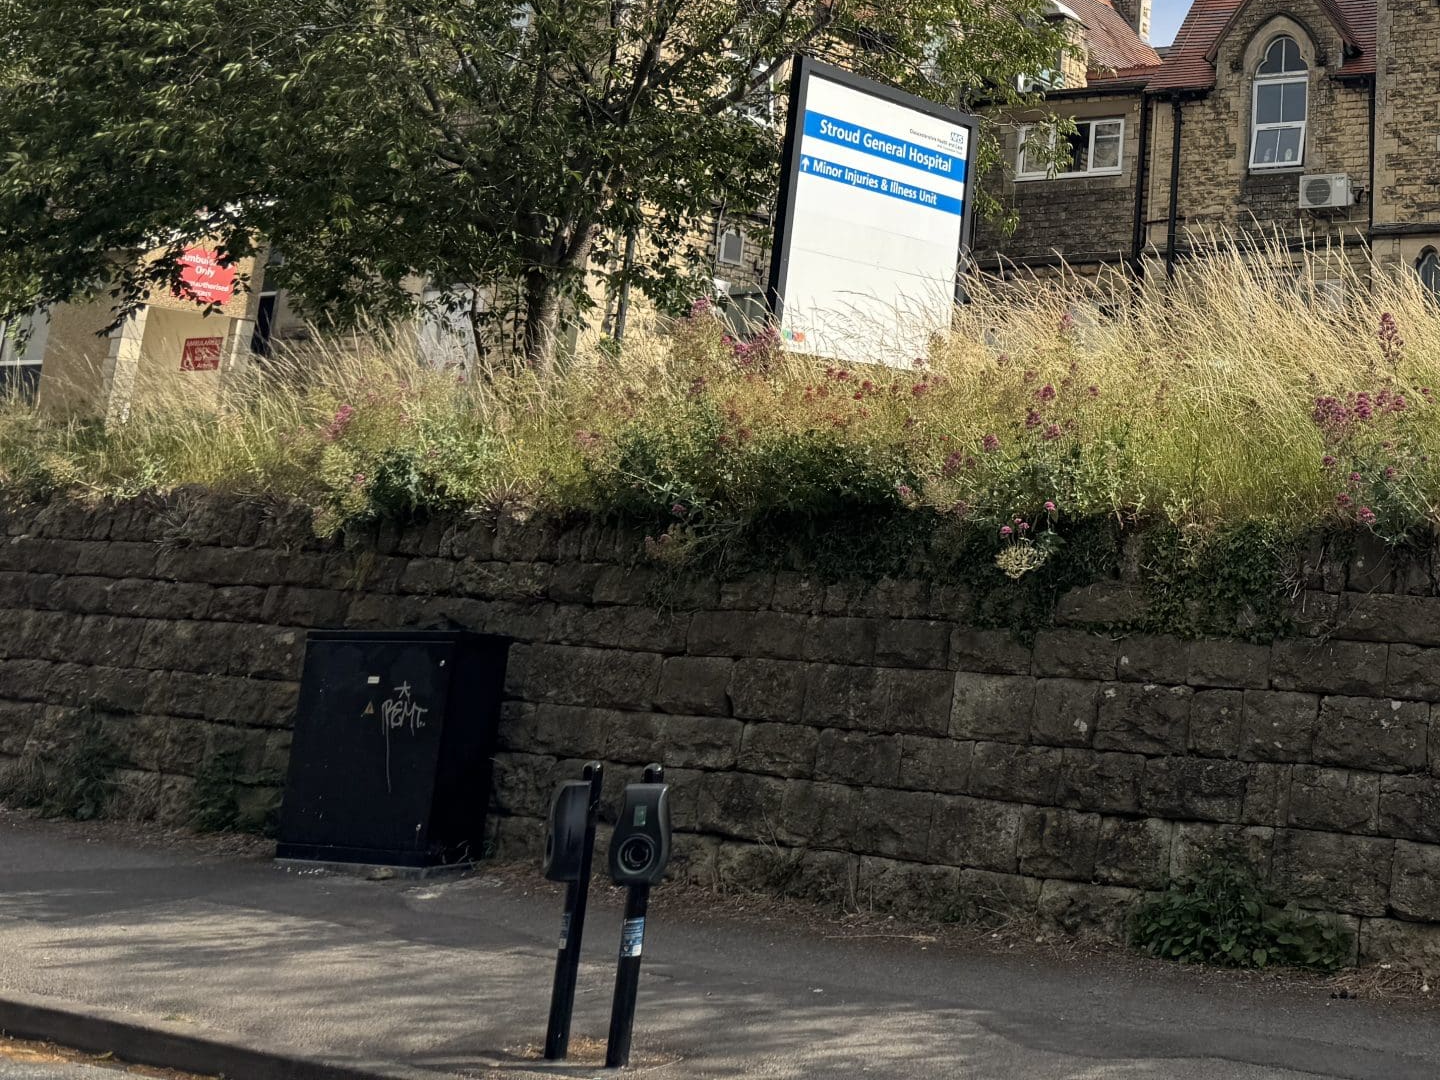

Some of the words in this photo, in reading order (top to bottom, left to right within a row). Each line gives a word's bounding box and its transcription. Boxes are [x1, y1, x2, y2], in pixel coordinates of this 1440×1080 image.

[819, 119, 861, 145] Stroud
[863, 133, 906, 159] General
[908, 146, 952, 173] Hospital
[813, 159, 843, 178] Minor
[844, 168, 879, 188] Injuries
[880, 179, 888, 191] &
[890, 180, 917, 199] Illness
[919, 189, 937, 206] Unit
[195, 265, 215, 278] Only
